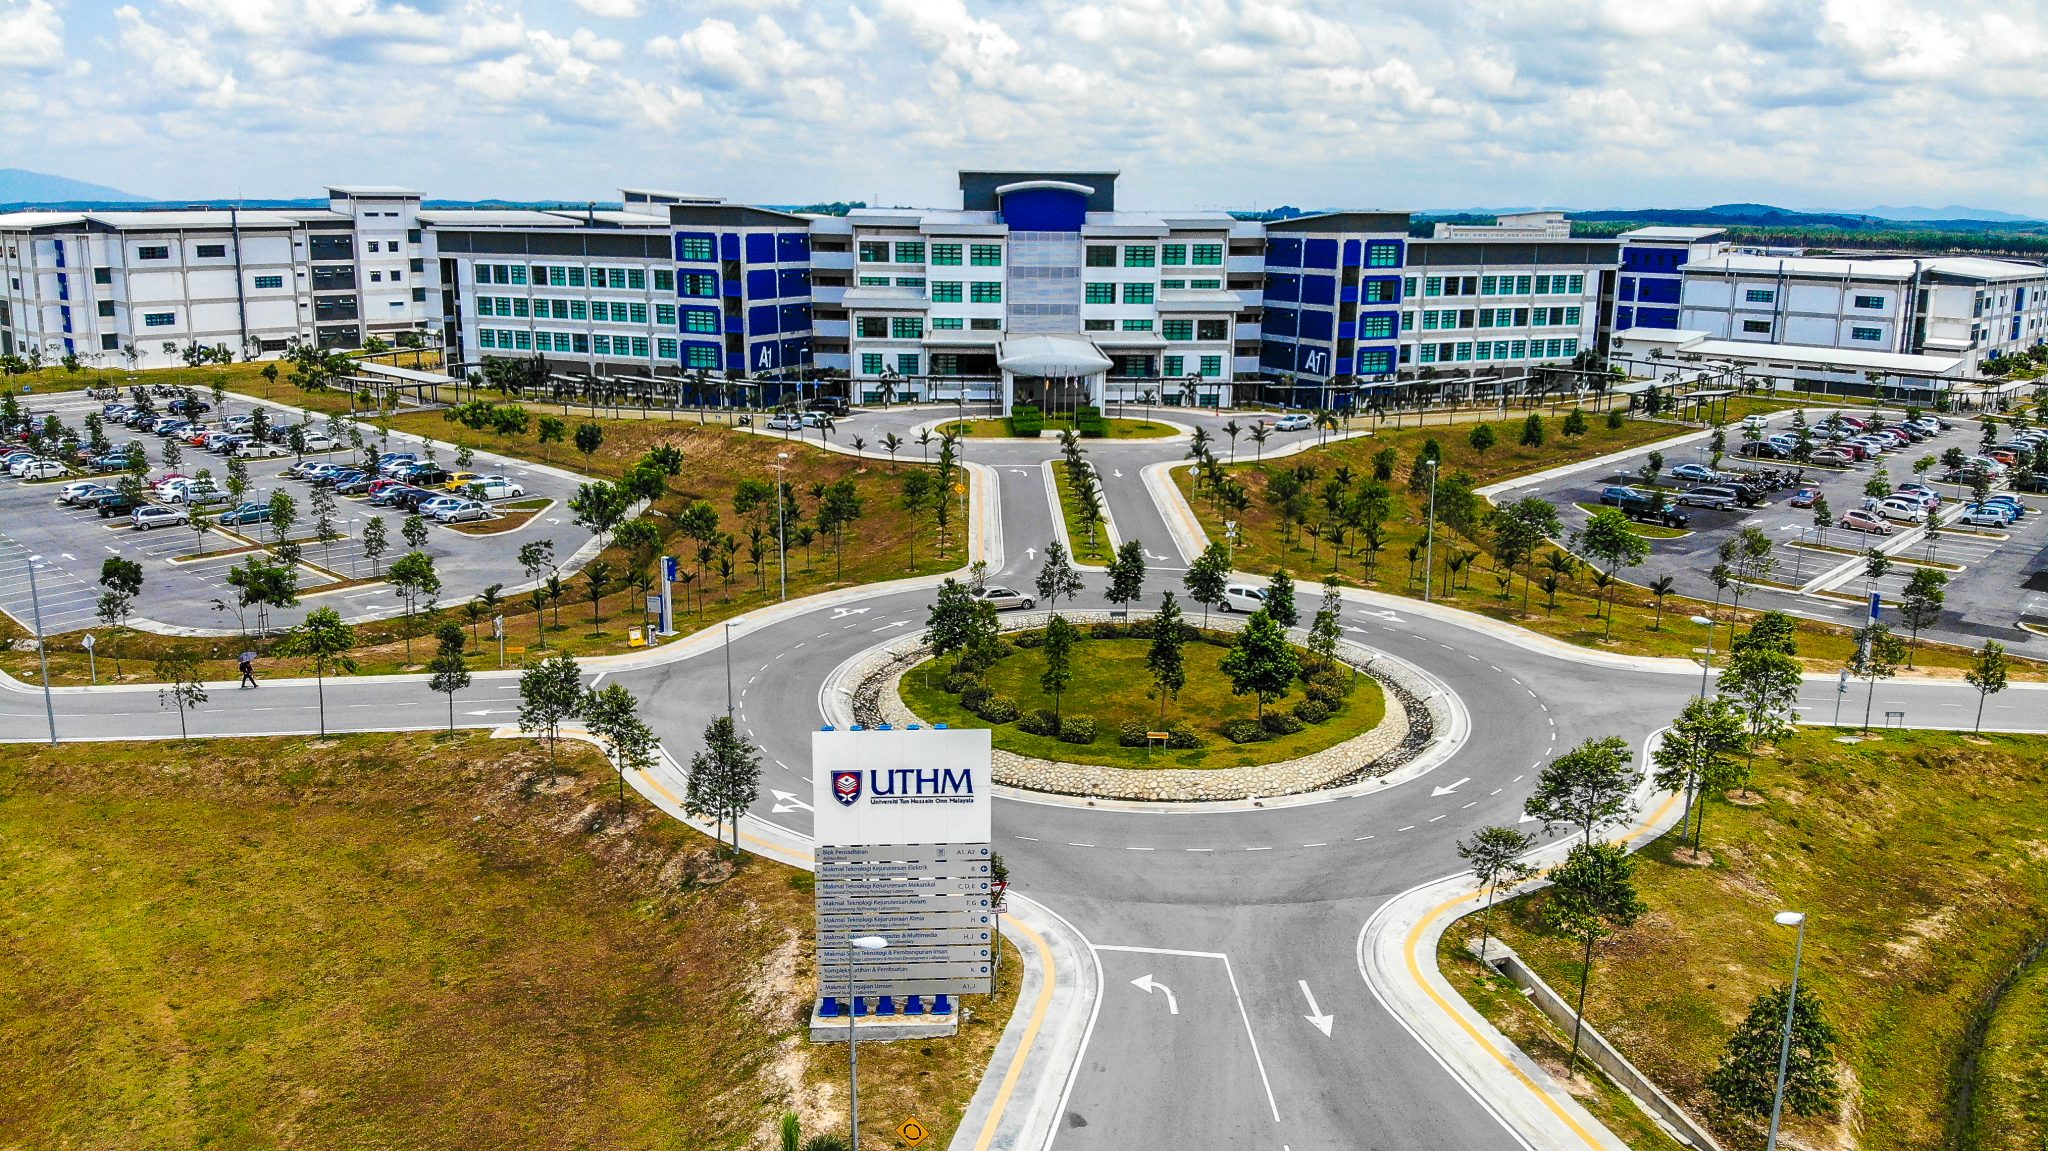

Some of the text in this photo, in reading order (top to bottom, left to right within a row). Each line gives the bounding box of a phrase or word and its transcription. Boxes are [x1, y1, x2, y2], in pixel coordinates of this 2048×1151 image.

[759, 346, 772, 368] A1
[1305, 350, 1320, 373] A1
[870, 768, 973, 796] UTHM
